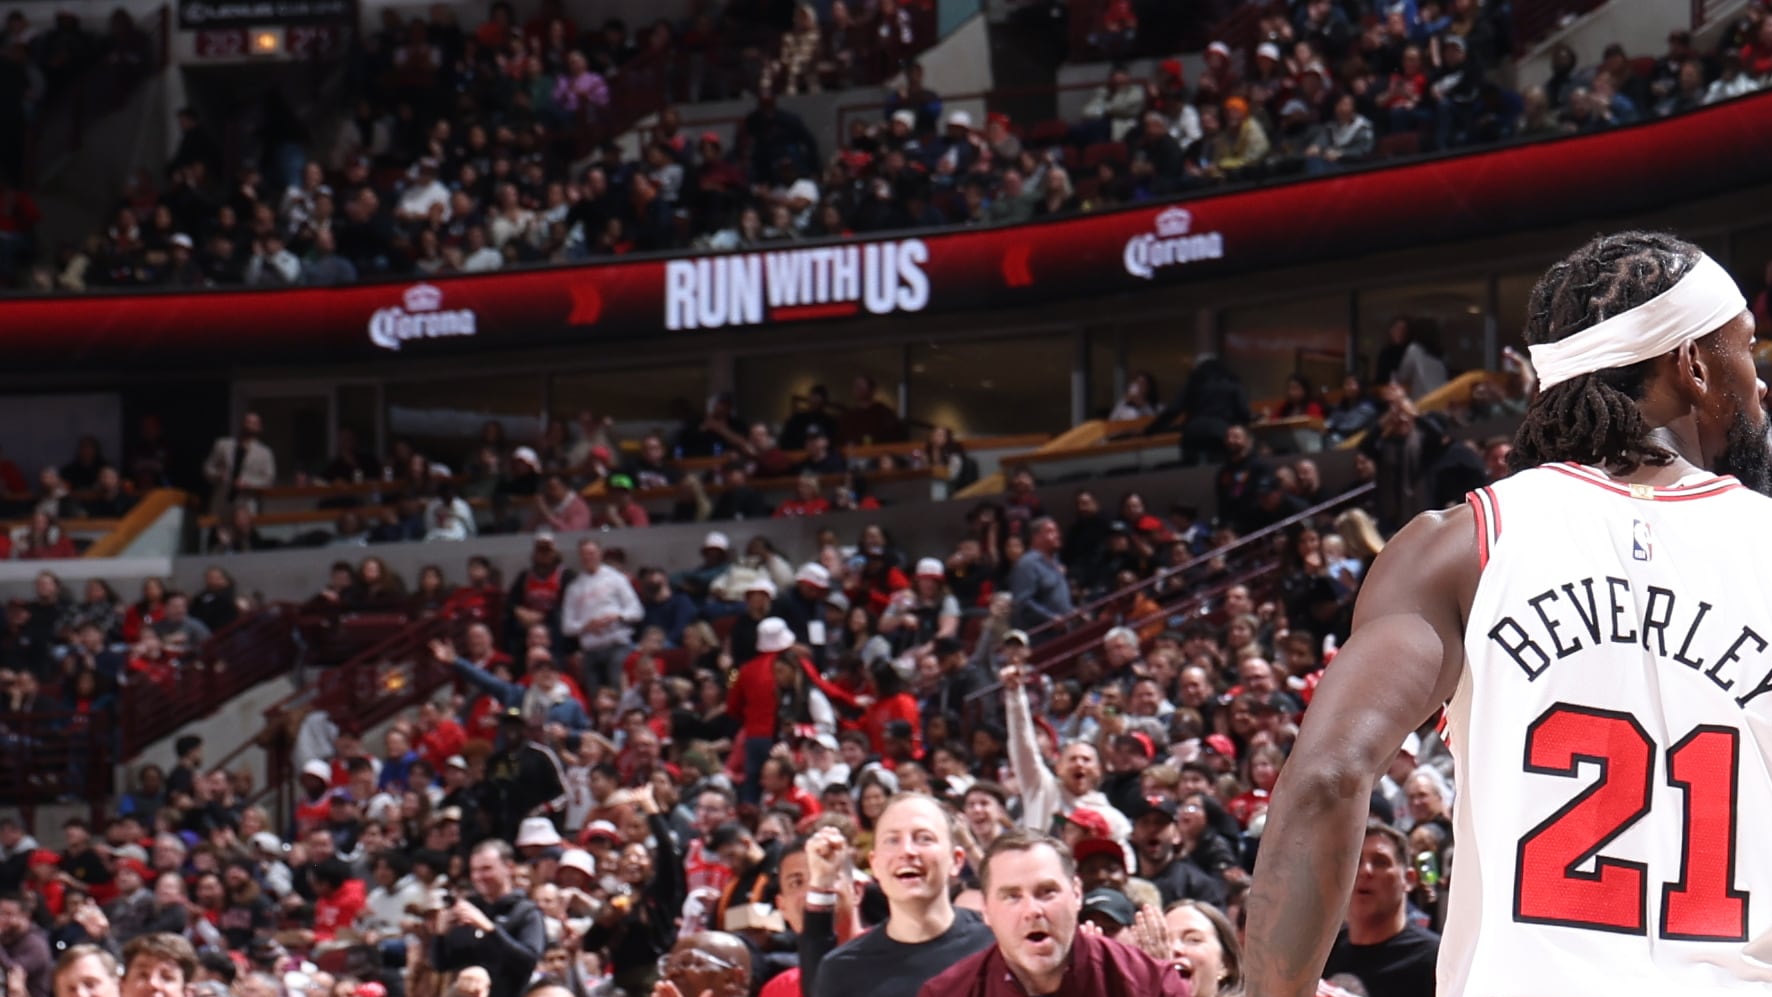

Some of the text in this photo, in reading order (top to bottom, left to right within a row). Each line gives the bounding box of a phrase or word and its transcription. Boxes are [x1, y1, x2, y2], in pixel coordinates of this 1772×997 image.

[665, 239, 930, 330] RUN WITH US
[1123, 231, 1224, 279] Corona
[368, 305, 476, 350] Corona
[1512, 702, 1750, 942] 21
